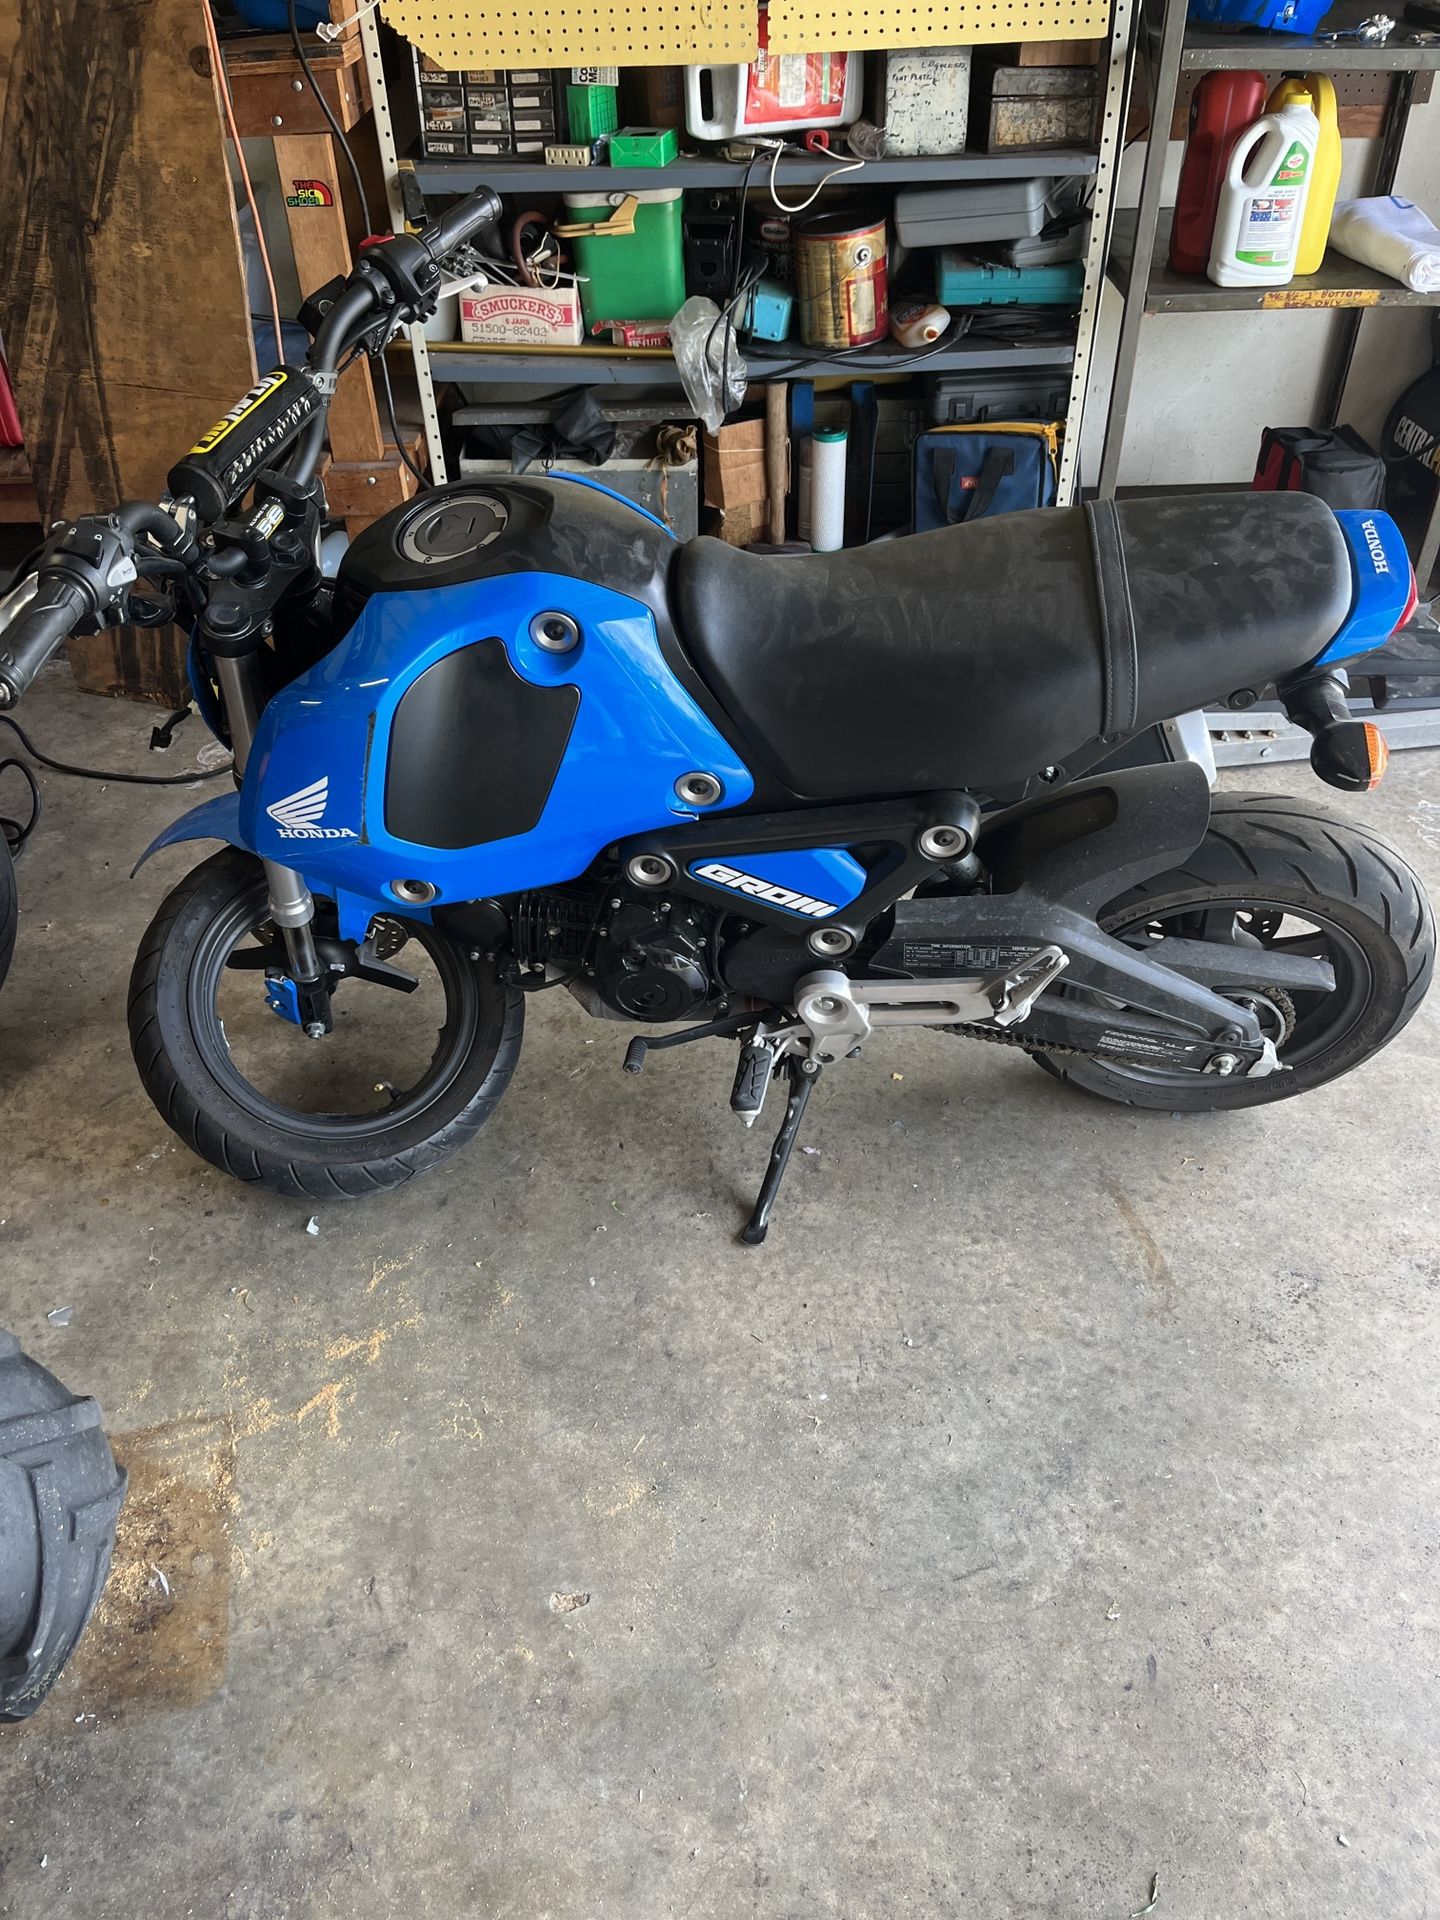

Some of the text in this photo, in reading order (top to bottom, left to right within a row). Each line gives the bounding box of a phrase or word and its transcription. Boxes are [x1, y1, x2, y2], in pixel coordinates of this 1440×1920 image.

[294, 181, 313, 189] THE
[298, 189, 315, 198] SIC
[287, 197, 315, 206] SHOP
[1321, 290, 1362, 300] BOTTOM
[480, 298, 557, 320] SMUCKER'S
[1314, 300, 1341, 309] ONLY
[511, 318, 529, 326] JARS
[471, 322, 548, 337] 51500-82402
[1361, 519, 1389, 574] HONDA
[276, 828, 358, 839] HONDA
[694, 864, 838, 917] GROM
